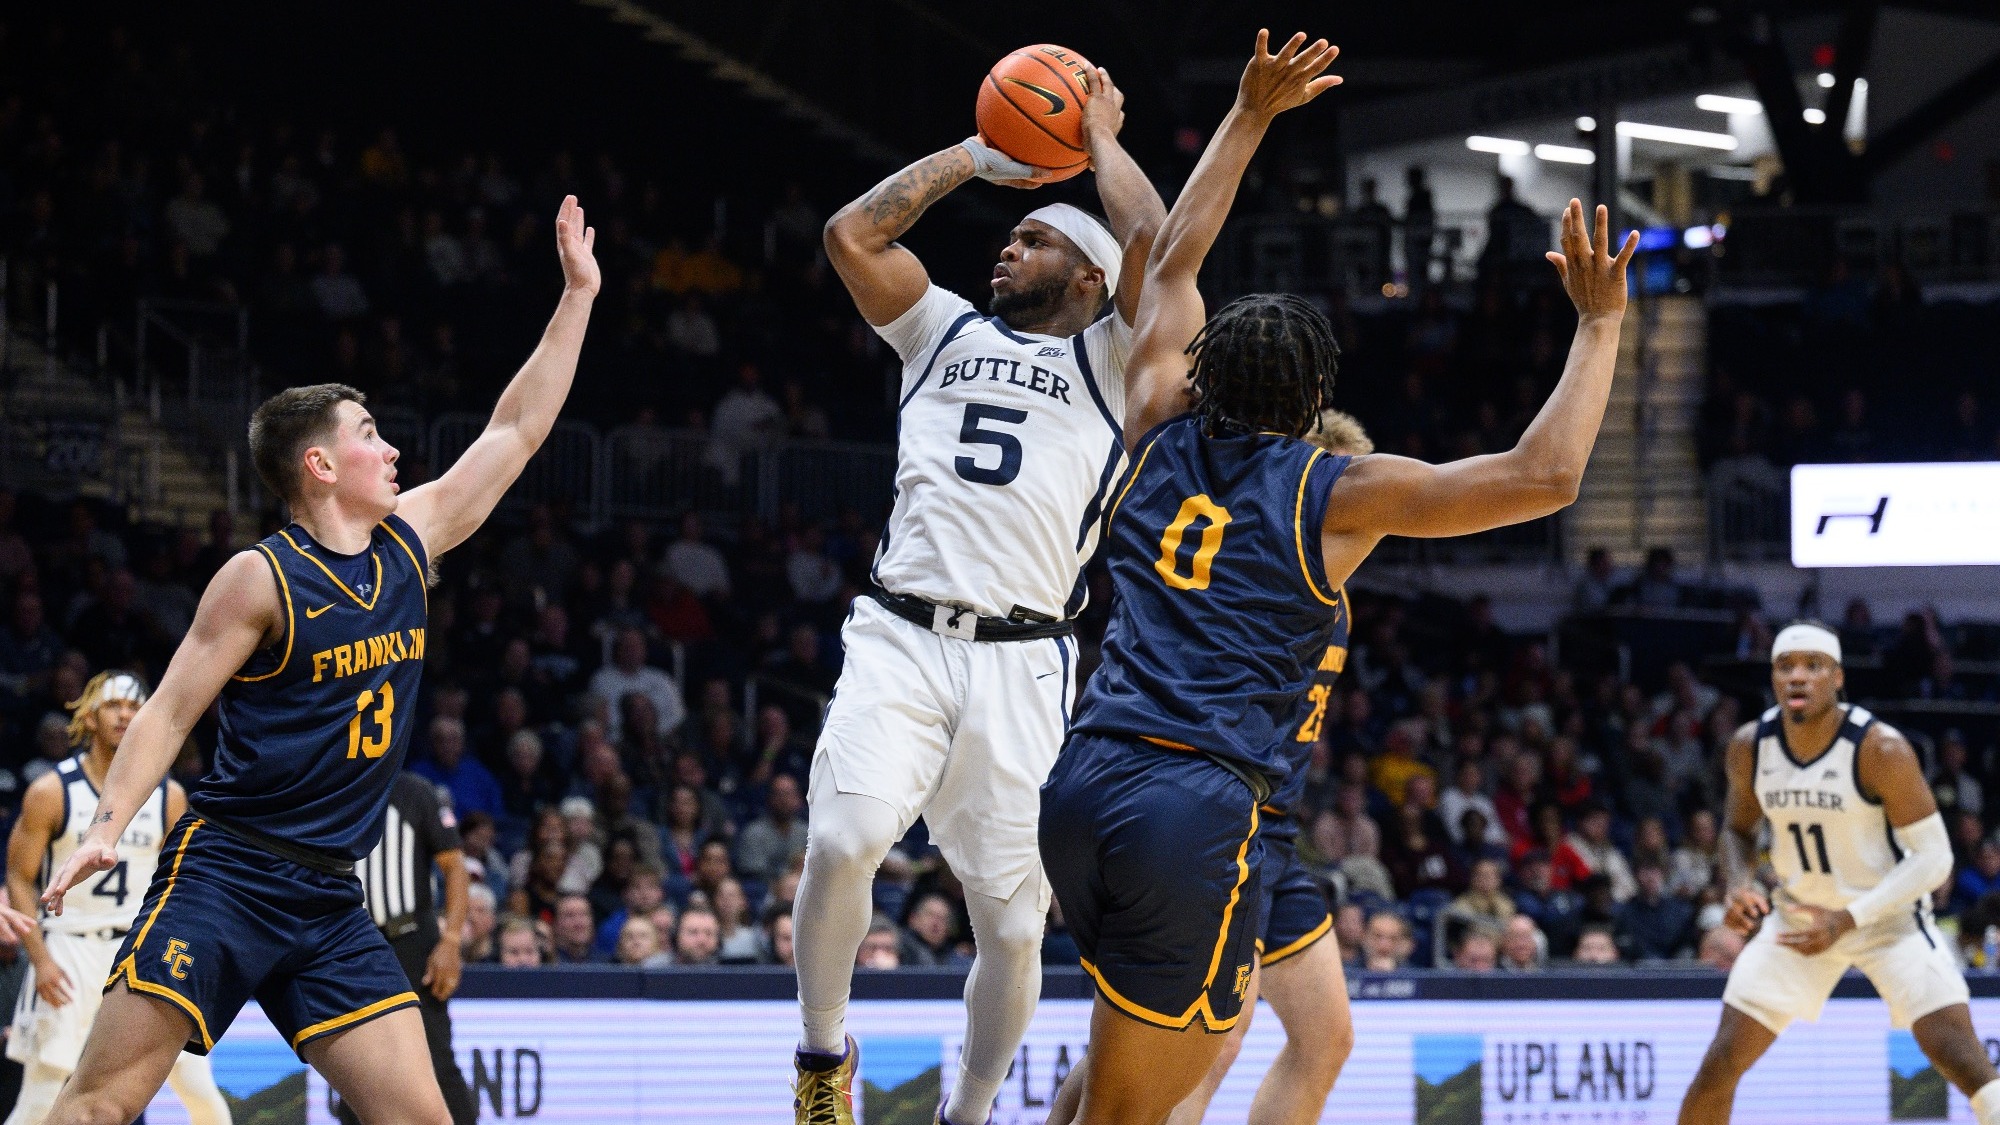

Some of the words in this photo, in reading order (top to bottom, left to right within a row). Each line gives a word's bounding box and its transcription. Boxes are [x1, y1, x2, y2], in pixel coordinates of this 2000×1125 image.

[1039, 46, 1090, 95] ELITE
[939, 357, 1071, 405] BUTLER
[955, 403, 1029, 487] 5
[1154, 493, 1233, 590] 0
[312, 628, 425, 682] FRANKLIN
[346, 680, 394, 759] 13
[1765, 789, 1845, 813] BUTLER
[1788, 823, 1831, 874] 11
[92, 861, 129, 906] 4
[161, 937, 194, 980] FC
[1497, 1041, 1655, 1101] UPLAND
